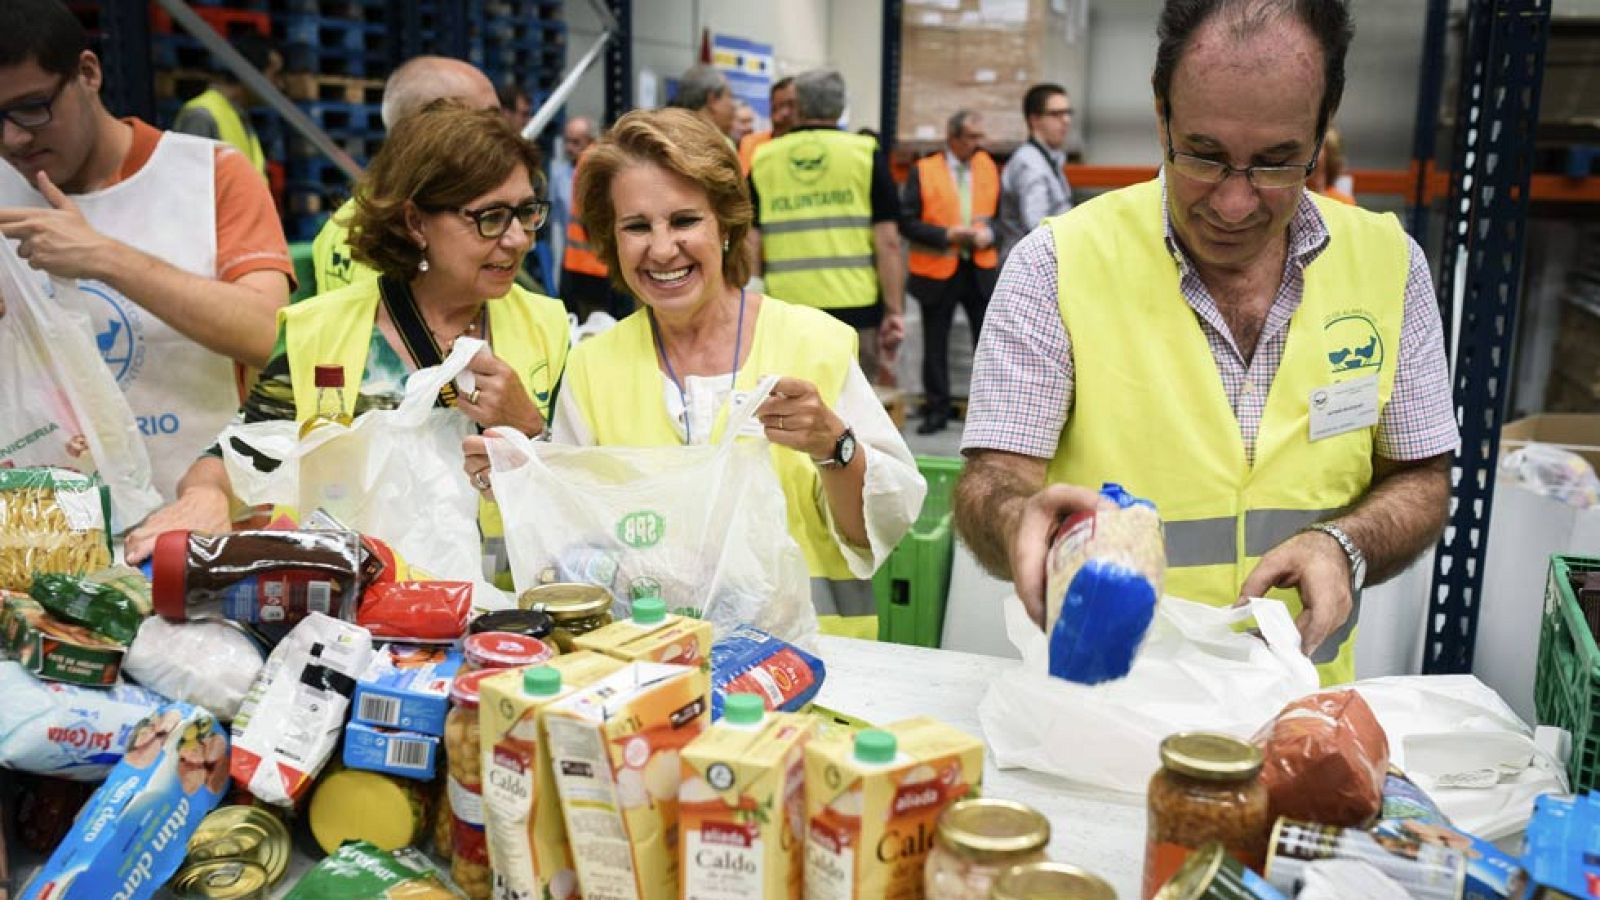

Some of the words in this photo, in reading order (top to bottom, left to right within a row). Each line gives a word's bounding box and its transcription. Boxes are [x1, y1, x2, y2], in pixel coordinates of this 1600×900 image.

[771, 188, 854, 211] VOLUNTARIO
[489, 770, 527, 798] Caldo
[152, 797, 190, 852] atún
[696, 848, 757, 876] Caldo
